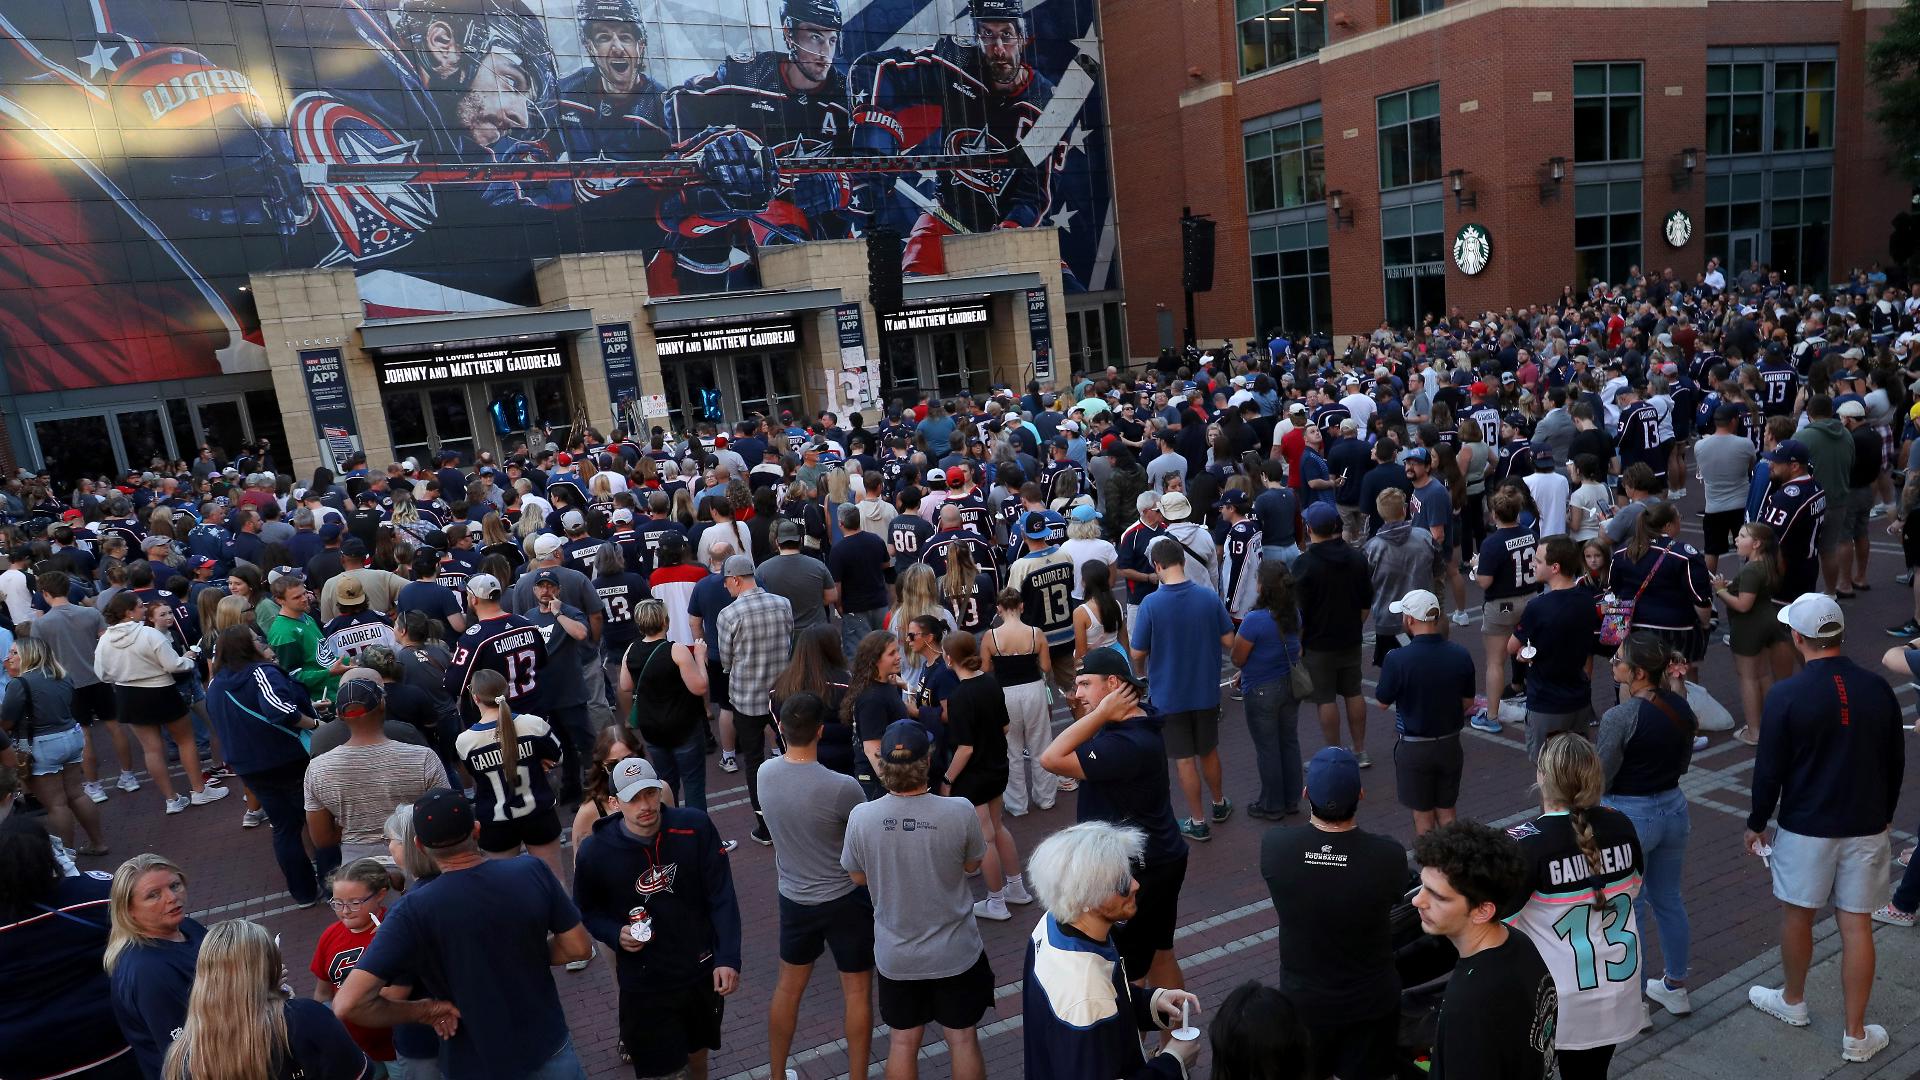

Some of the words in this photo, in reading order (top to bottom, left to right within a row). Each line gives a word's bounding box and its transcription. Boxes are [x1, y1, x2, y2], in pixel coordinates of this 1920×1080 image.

[821, 111, 837, 136] A
[1030, 302, 1045, 311] APP
[841, 321, 858, 331] APP
[908, 313, 946, 329] MATTHEW
[947, 310, 987, 325] GAUDREAU
[607, 344, 628, 354] APP
[656, 341, 685, 356] HNNY
[702, 334, 747, 351] MATTHEW
[749, 330, 796, 347] GAUDREAU
[320, 356, 338, 364] BLUE
[446, 353, 475, 361] LOVING
[477, 350, 509, 358] MEMORY
[307, 363, 339, 372] JACKETS
[384, 366, 427, 384] JOHNNY
[429, 366, 448, 380] AND
[450, 358, 503, 378] MATTHEW
[506, 353, 562, 372] GAUDREAU
[1764, 372, 1791, 382] GAUDREAU
[312, 372, 338, 384] APP
[1768, 382, 1786, 404] 13
[1481, 421, 1498, 447] 13
[1643, 421, 1660, 449] 13
[1041, 474, 1049, 484] 13
[960, 511, 978, 522] REAU
[1004, 507, 1015, 518] 13
[1766, 507, 1788, 526] 13
[892, 529, 918, 553] 80
[1231, 540, 1244, 555] 13
[1512, 547, 1537, 588] 13
[436, 574, 463, 588] DREAU
[175, 605, 190, 620] 13
[604, 596, 632, 623] 13
[1040, 583, 1071, 626] 13
[337, 627, 383, 648] GAUDREAU
[493, 630, 536, 654] GAUDREAU
[451, 647, 469, 666] 13
[506, 649, 537, 698] 13
[470, 740, 534, 771] GAUDAU
[484, 765, 537, 822] 13
[1304, 852, 1348, 862] FOUNDATION
[1552, 892, 1639, 991] 13
